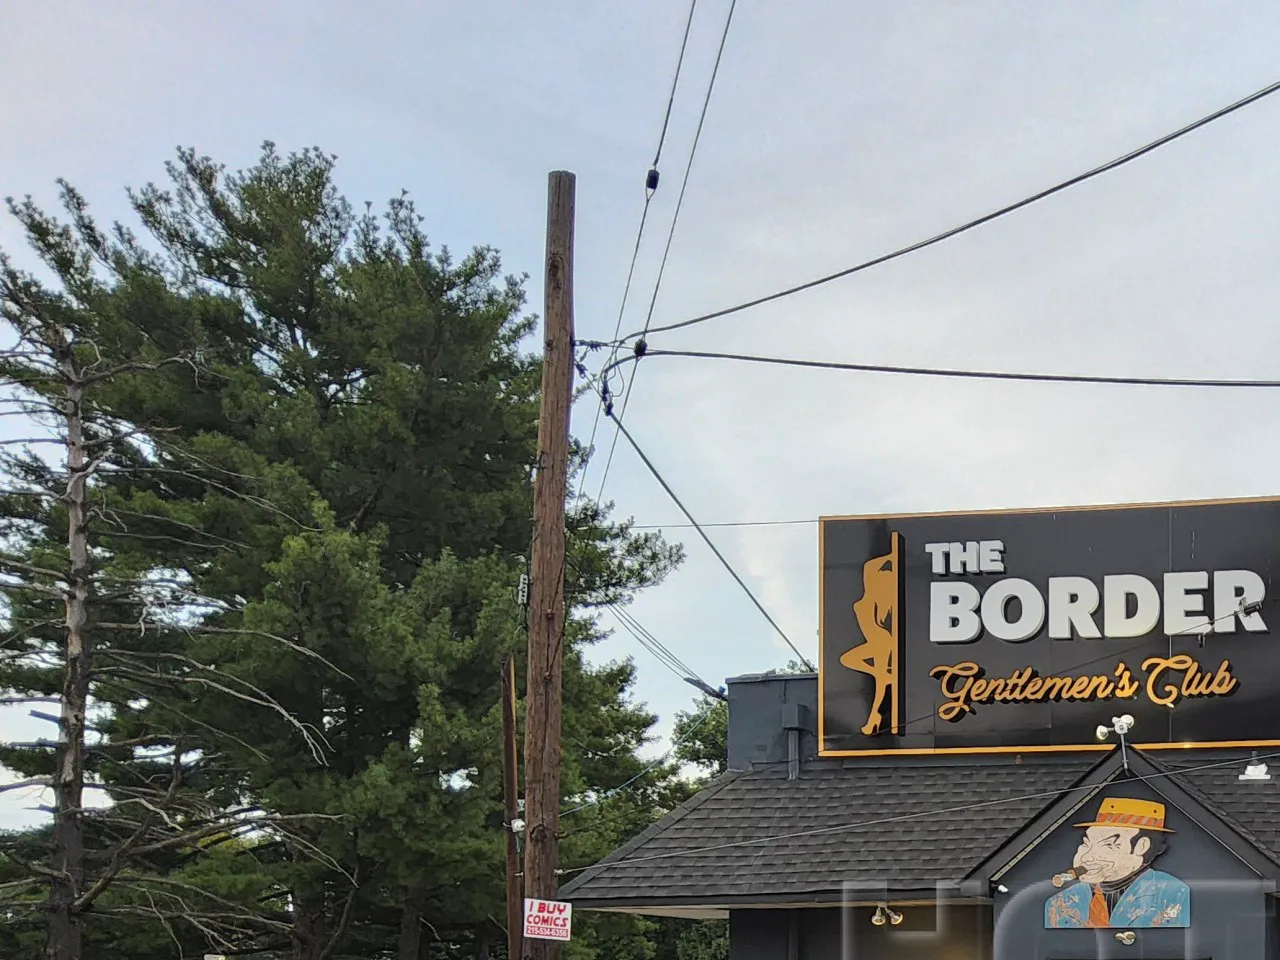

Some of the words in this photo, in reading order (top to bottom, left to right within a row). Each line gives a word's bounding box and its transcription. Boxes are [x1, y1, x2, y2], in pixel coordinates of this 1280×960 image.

[925, 540, 1005, 574] THE
[929, 569, 1271, 642] BORDER
[929, 661, 1138, 720] Gentlemen's
[1142, 654, 1238, 707] Club
[526, 914, 569, 927] COMICS
[529, 901, 534, 912] I
[537, 902, 567, 915] BUY
